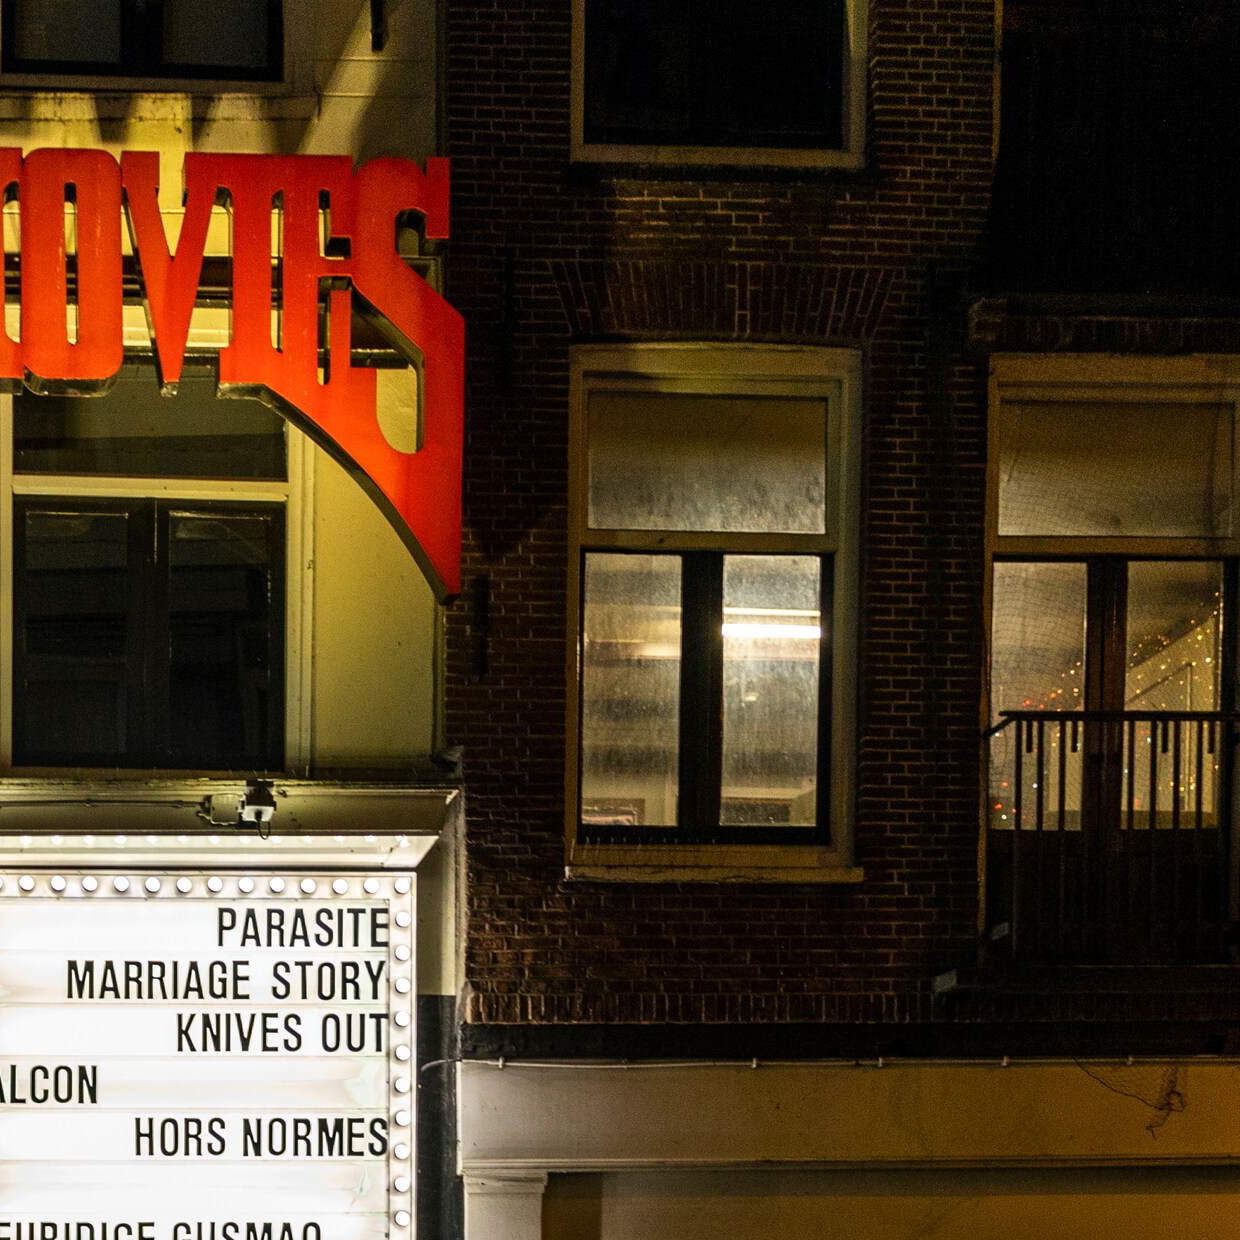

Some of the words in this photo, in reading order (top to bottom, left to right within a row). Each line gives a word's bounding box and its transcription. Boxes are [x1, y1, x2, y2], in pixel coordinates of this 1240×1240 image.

[219, 908, 389, 947] PARASITE
[68, 961, 249, 999] MARRIAGE
[273, 961, 389, 1000] STORY
[178, 1013, 301, 1051] KNIVES
[322, 1013, 390, 1055] OUT
[136, 1118, 225, 1156] HORS
[244, 1118, 389, 1156] NORMES
